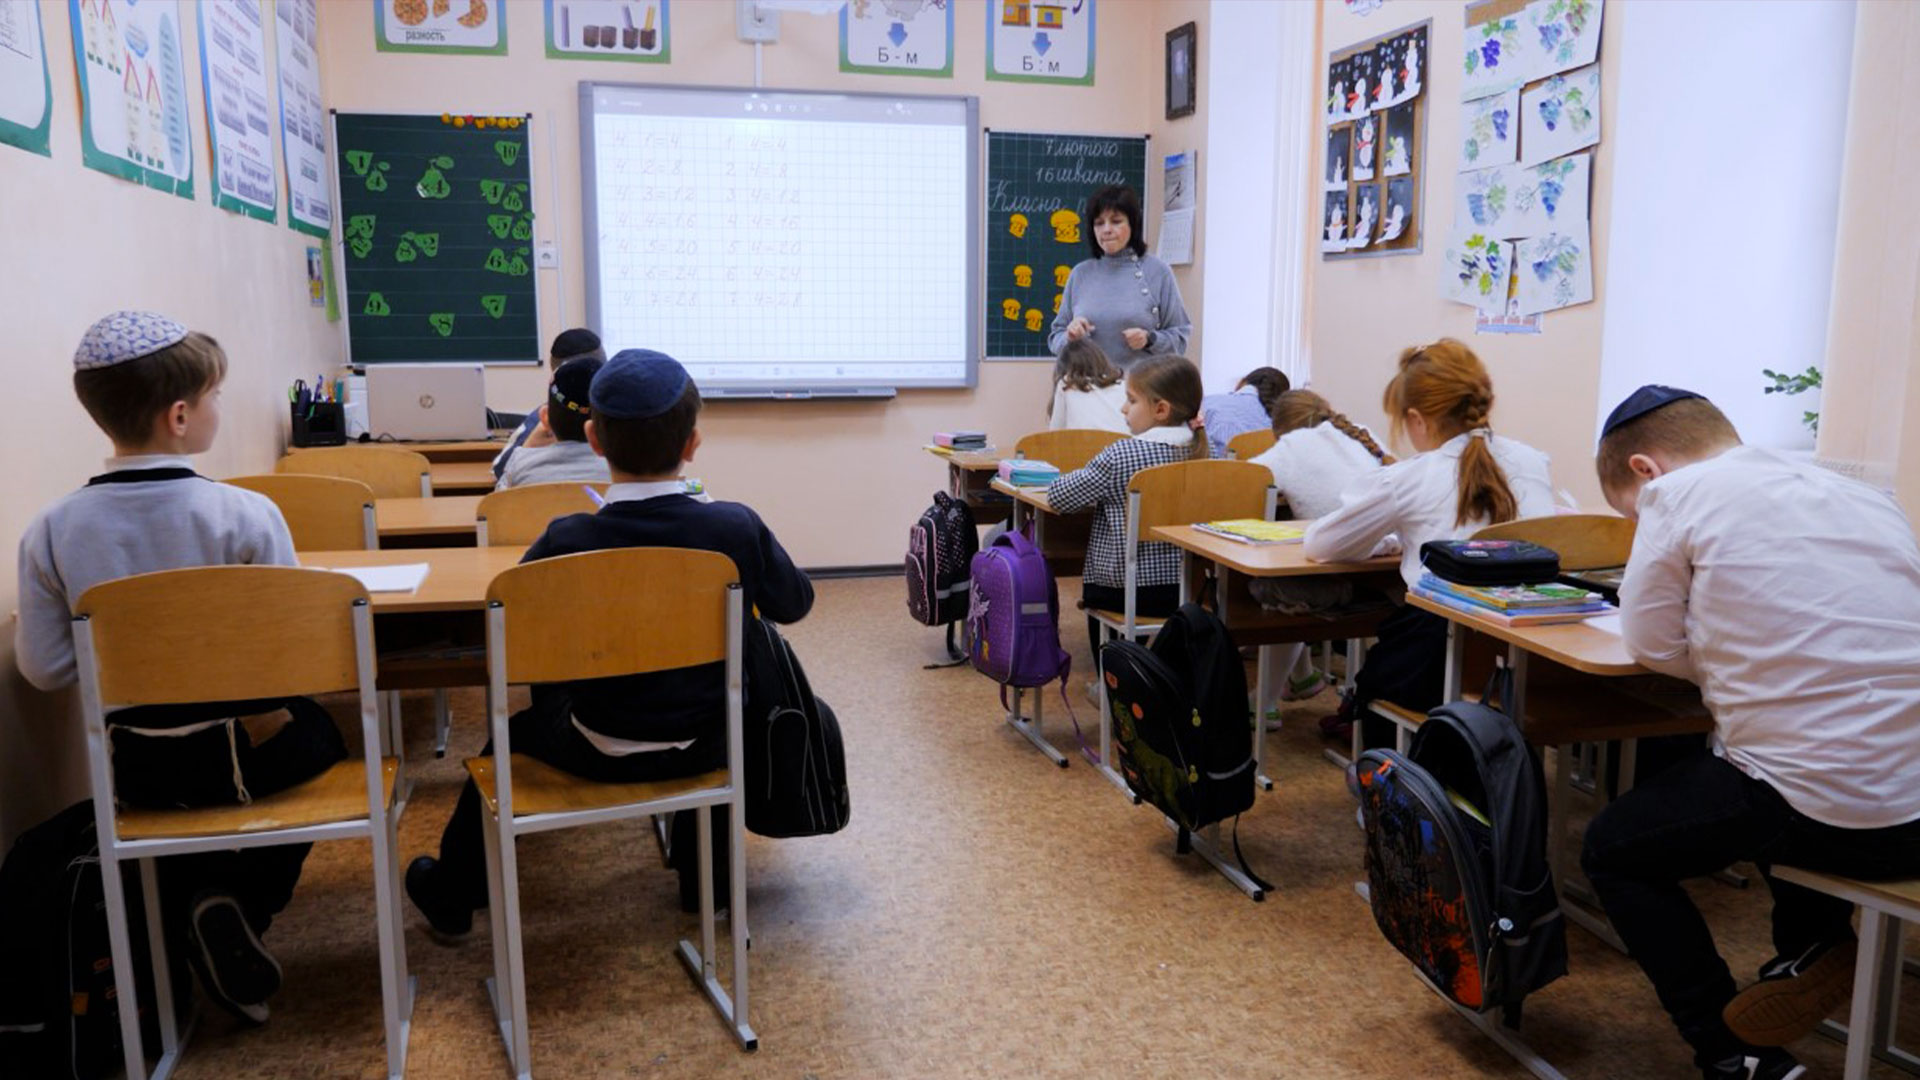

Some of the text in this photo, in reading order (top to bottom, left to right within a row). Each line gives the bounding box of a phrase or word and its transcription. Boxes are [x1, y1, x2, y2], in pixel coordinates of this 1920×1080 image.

[406, 31, 446, 42] разность
[877, 47, 889, 63] Б
[906, 53, 918, 64] м
[1022, 55, 1034, 72] Б
[1048, 62, 1060, 73] м
[1036, 157, 1126, 184] 16 швата
[989, 179, 1066, 212] Класна
